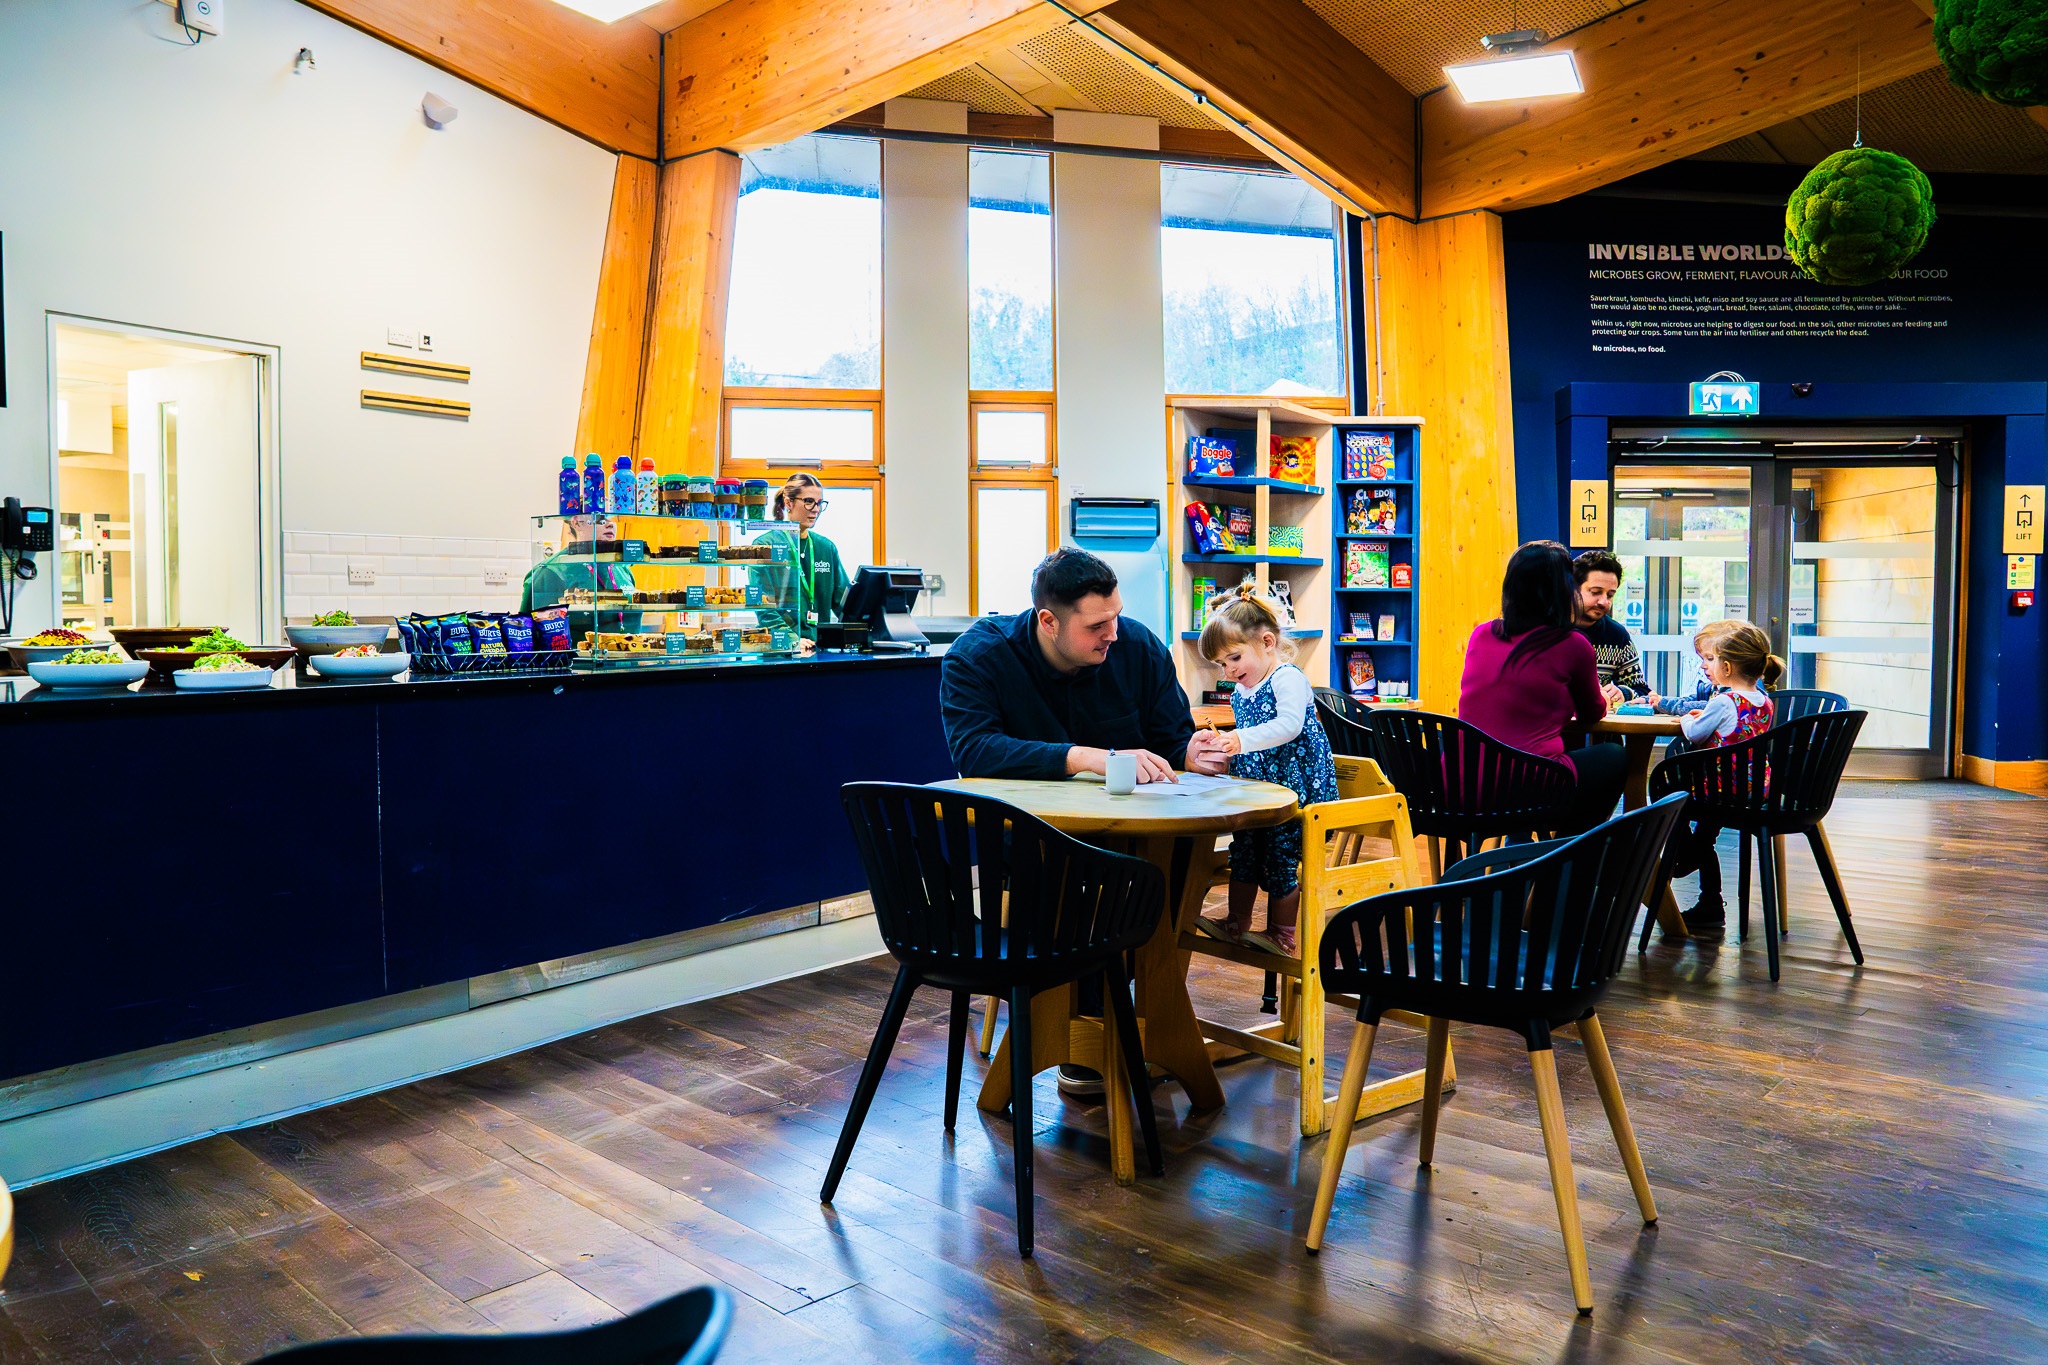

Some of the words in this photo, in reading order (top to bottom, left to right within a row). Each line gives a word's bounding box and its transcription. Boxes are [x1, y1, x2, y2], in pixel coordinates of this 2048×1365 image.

[1588, 243, 1695, 261] INVISIBLE
[1589, 269, 1644, 280] MICROBES
[1646, 270, 1683, 281] GROW,
[1685, 270, 1737, 281] FERMENT,
[1739, 270, 1788, 280] FLAVOUR
[1914, 269, 1949, 279] FOOD
[1590, 295, 1629, 303] Sauerkraut,
[1630, 295, 1667, 303] kombucha,
[1668, 295, 1693, 303] kimchi,
[1694, 295, 1712, 303] kefir,
[1745, 296, 1758, 304] soy
[1841, 295, 1851, 303] by
[1917, 295, 1953, 303] microbes,
[1668, 303, 1695, 311] cheese,
[1695, 303, 1725, 312] yoghurt,
[1725, 303, 1748, 311] bread,
[1794, 304, 1830, 312] chocolate,
[1832, 304, 1856, 312] coffee,
[1626, 320, 1642, 328] right
[1706, 320, 1733, 329] helping
[1742, 320, 1764, 329] digest
[1820, 320, 1836, 328] soil,
[1904, 320, 1932, 329] feeding
[1591, 329, 1627, 337] protecting
[1809, 329, 1835, 338] recycle
[1603, 345, 1637, 353] microbes,
[1647, 345, 1666, 353] food.
[1349, 437, 1382, 448] CONNECT
[1382, 434, 1391, 446] 4
[1201, 446, 1232, 460] Boggle
[1355, 489, 1389, 499] CLUEDO
[1230, 522, 1251, 533] MONOPOLY
[1581, 526, 1597, 534] LIFT
[814, 560, 831, 568] eden
[479, 629, 502, 637] BURTS
[508, 628, 532, 637] BURTS
